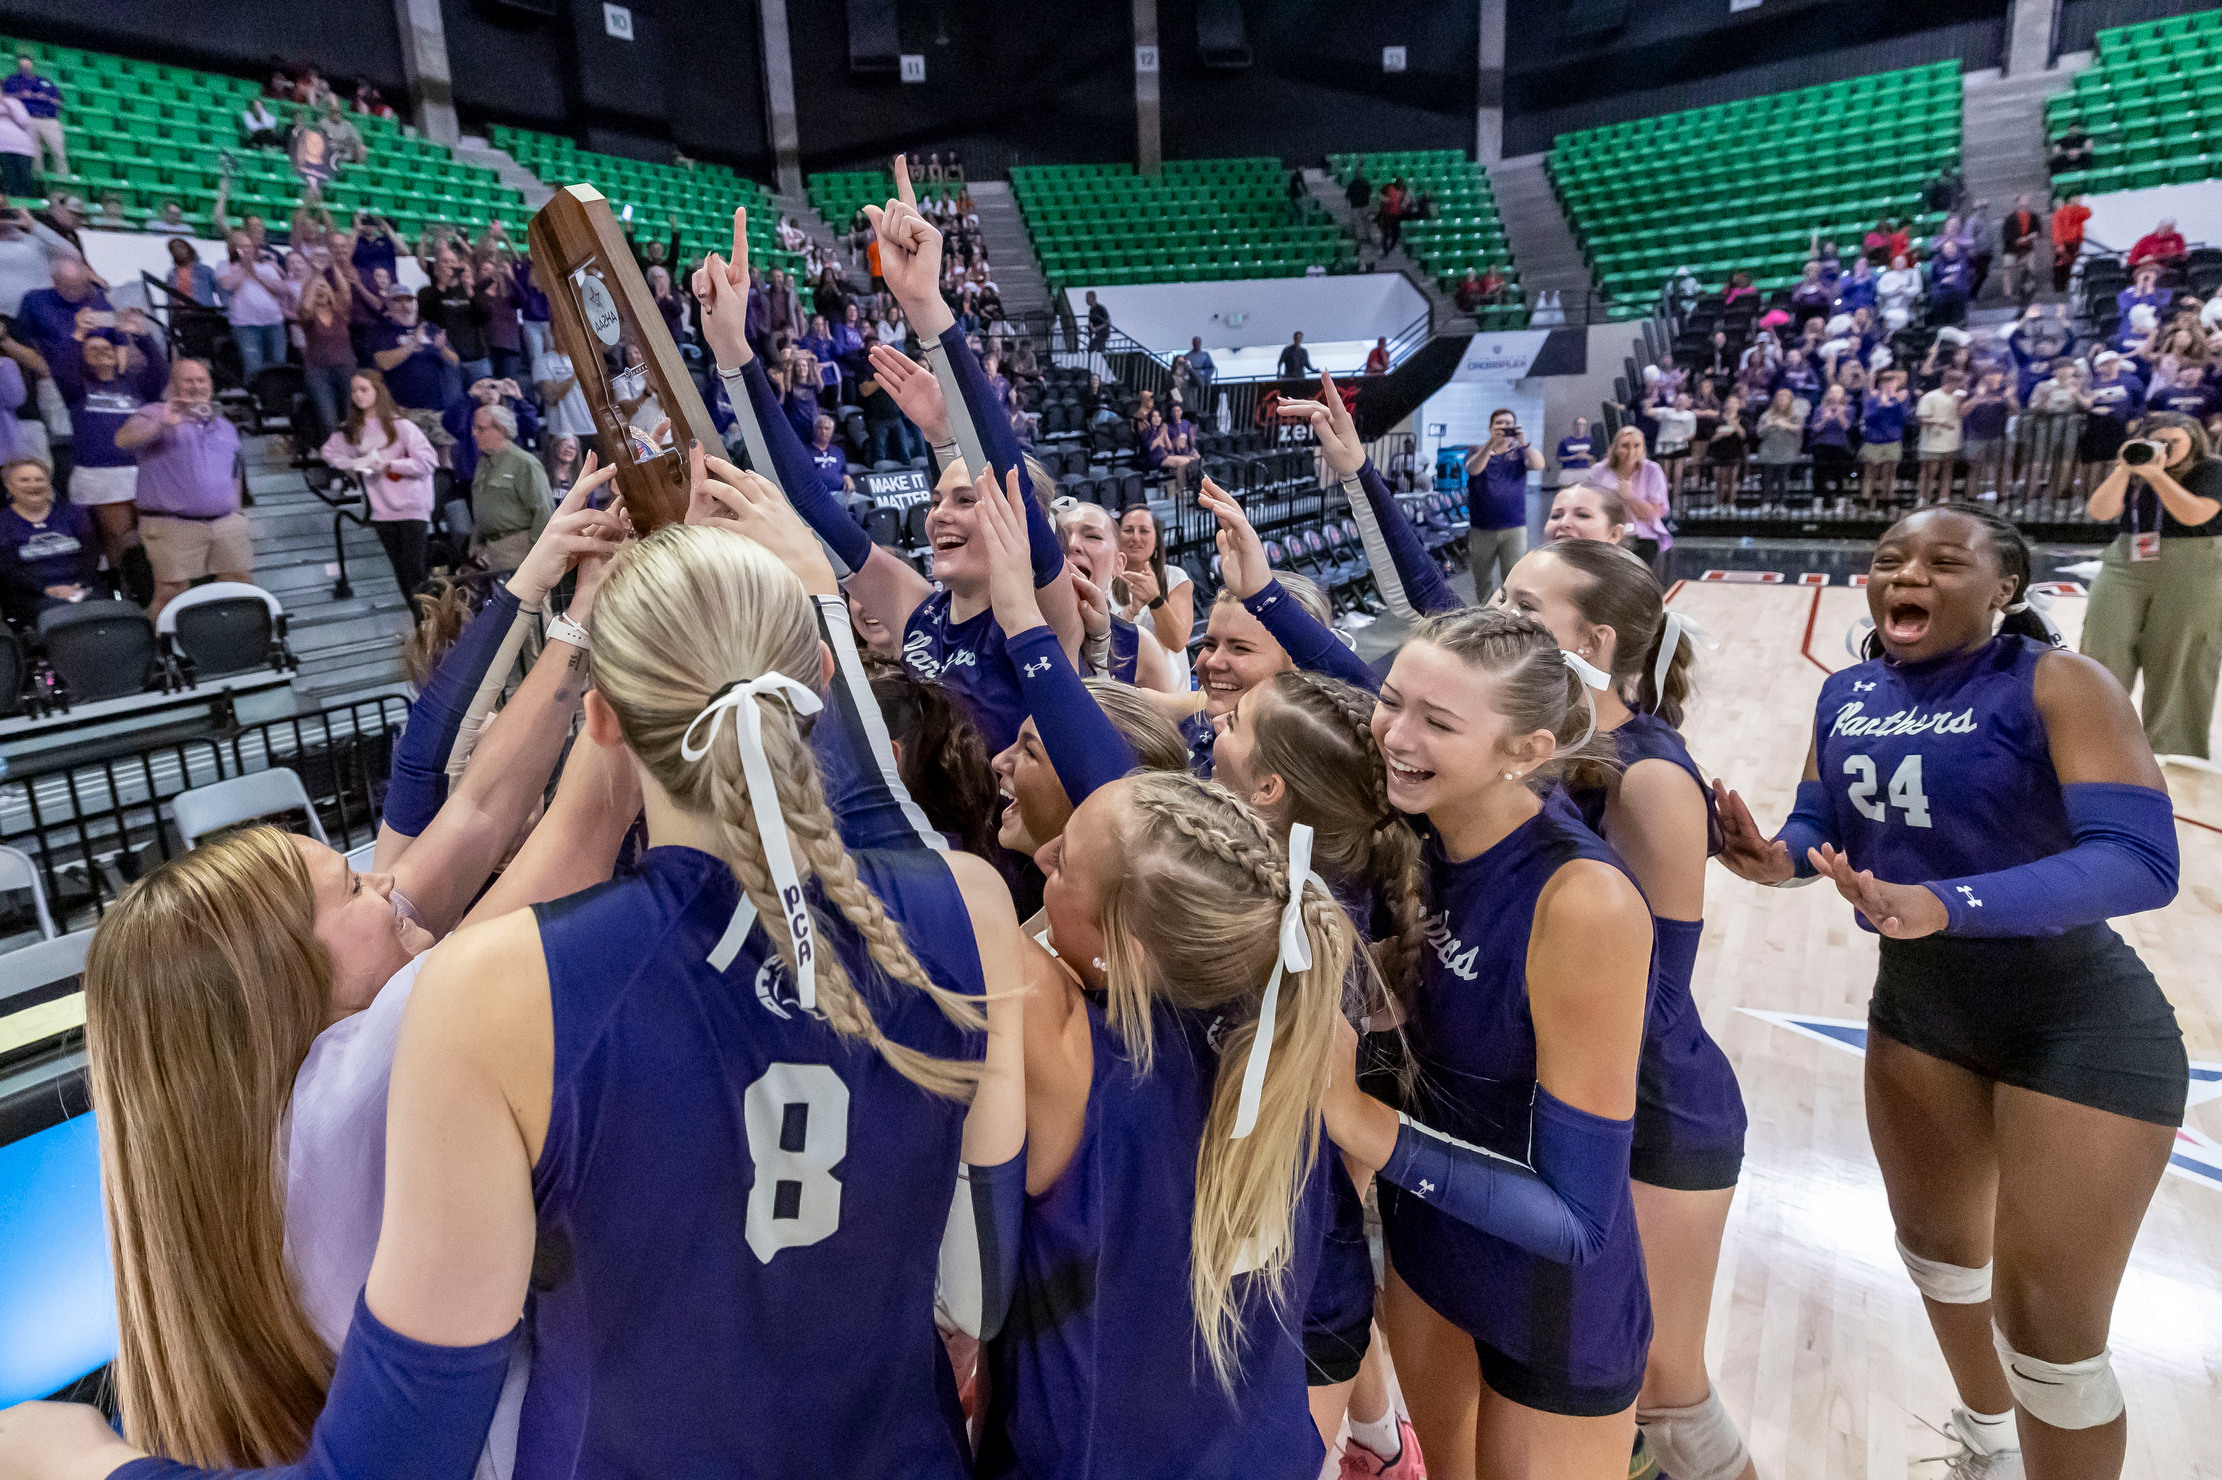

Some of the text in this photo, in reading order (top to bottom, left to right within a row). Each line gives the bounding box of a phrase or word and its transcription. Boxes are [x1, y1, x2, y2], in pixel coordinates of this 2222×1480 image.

[908, 61, 920, 75] 11
[870, 473, 923, 494] MAKE IT
[1829, 701, 1978, 737] Panthers
[1842, 754, 1933, 828] 24
[744, 1061, 850, 1265] 8
